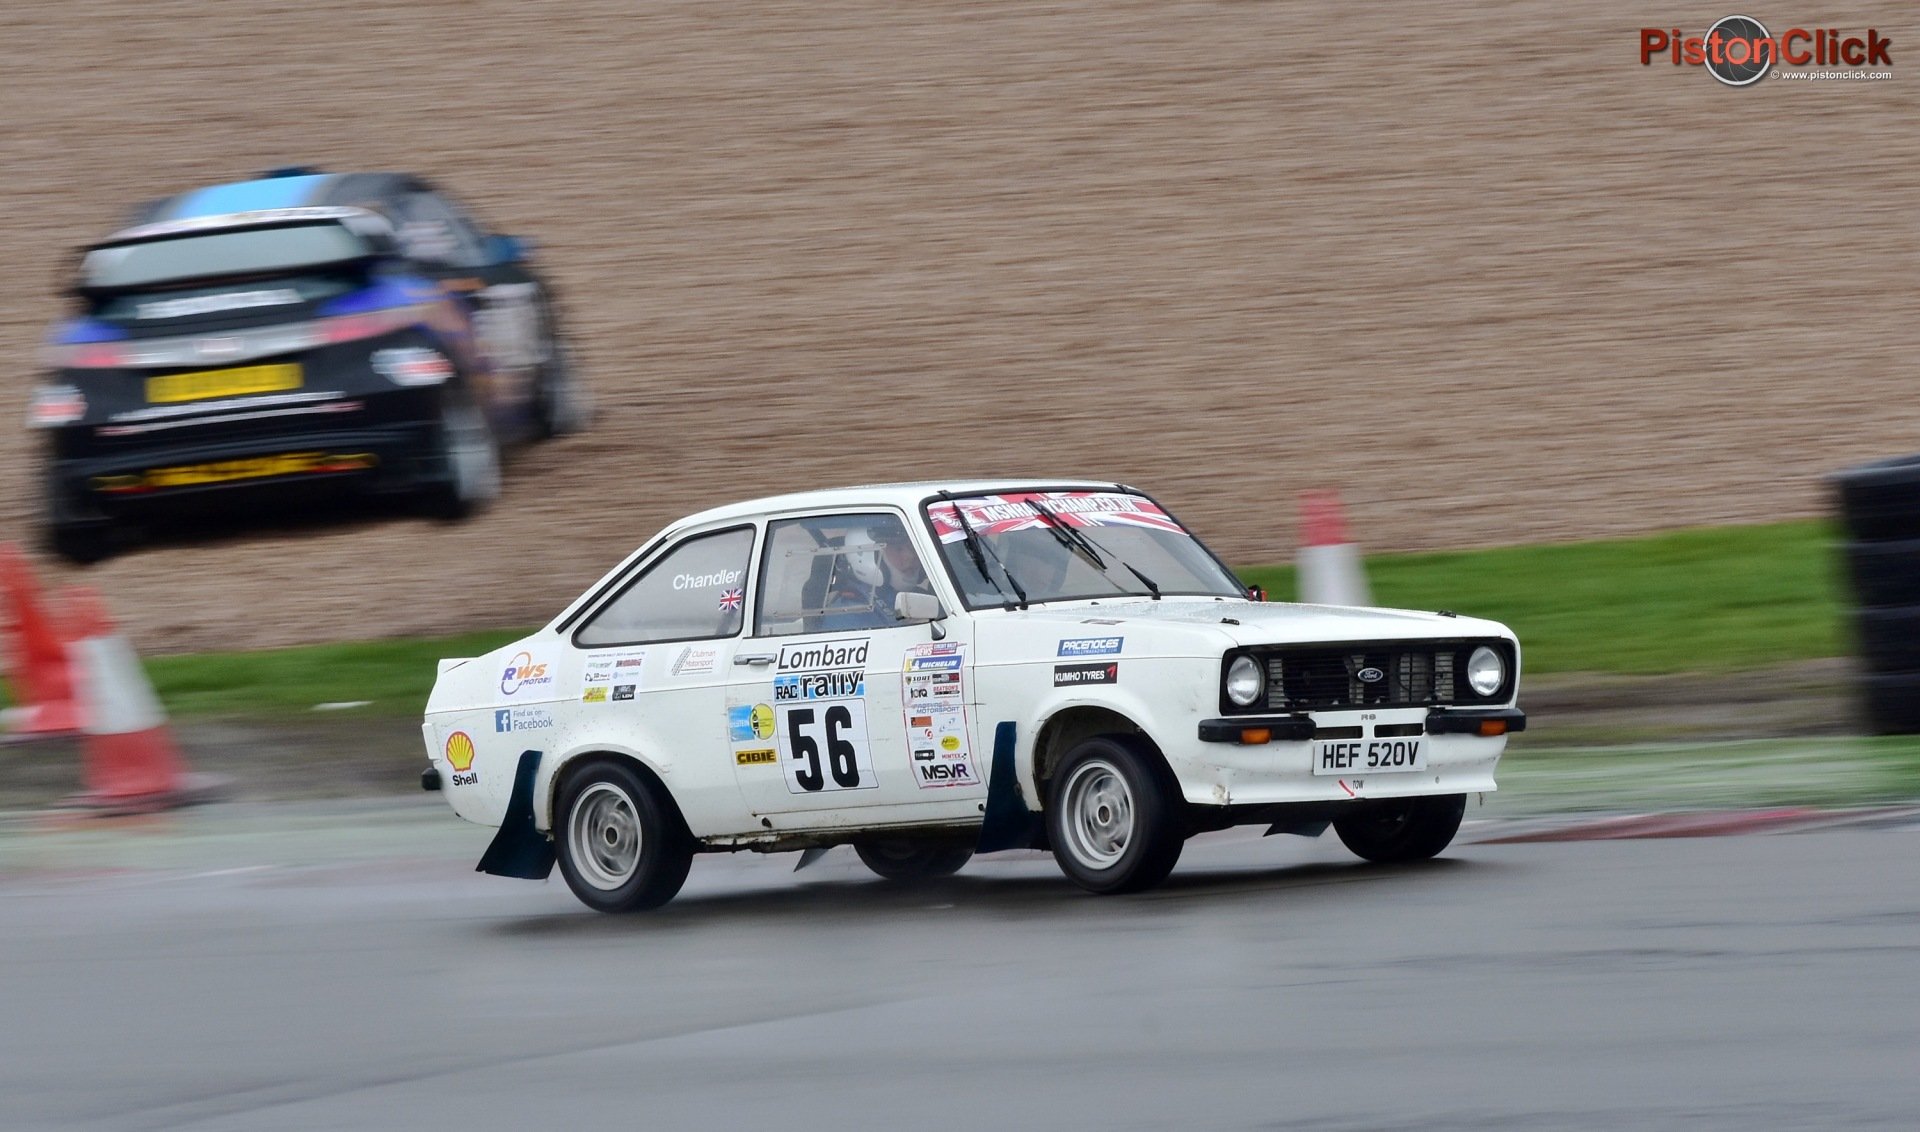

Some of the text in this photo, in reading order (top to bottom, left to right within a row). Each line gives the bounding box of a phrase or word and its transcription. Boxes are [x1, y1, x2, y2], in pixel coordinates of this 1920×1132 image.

[673, 569, 741, 590] Chandler
[778, 641, 869, 669] Lombard
[502, 663, 548, 680] RWS
[920, 660, 957, 669] MICHELIN
[522, 676, 552, 686] MOTORS
[1054, 670, 1105, 682] KUMHO TYRES
[776, 673, 863, 700] RAC rally
[917, 706, 960, 714] MOTORSPORT
[513, 716, 553, 730] Facebook
[788, 705, 860, 791] 56
[1322, 741, 1419, 769] HEF 520V
[920, 763, 970, 780] MSVR
[452, 773, 478, 787] Shell
[1353, 780, 1364, 790] TOW
